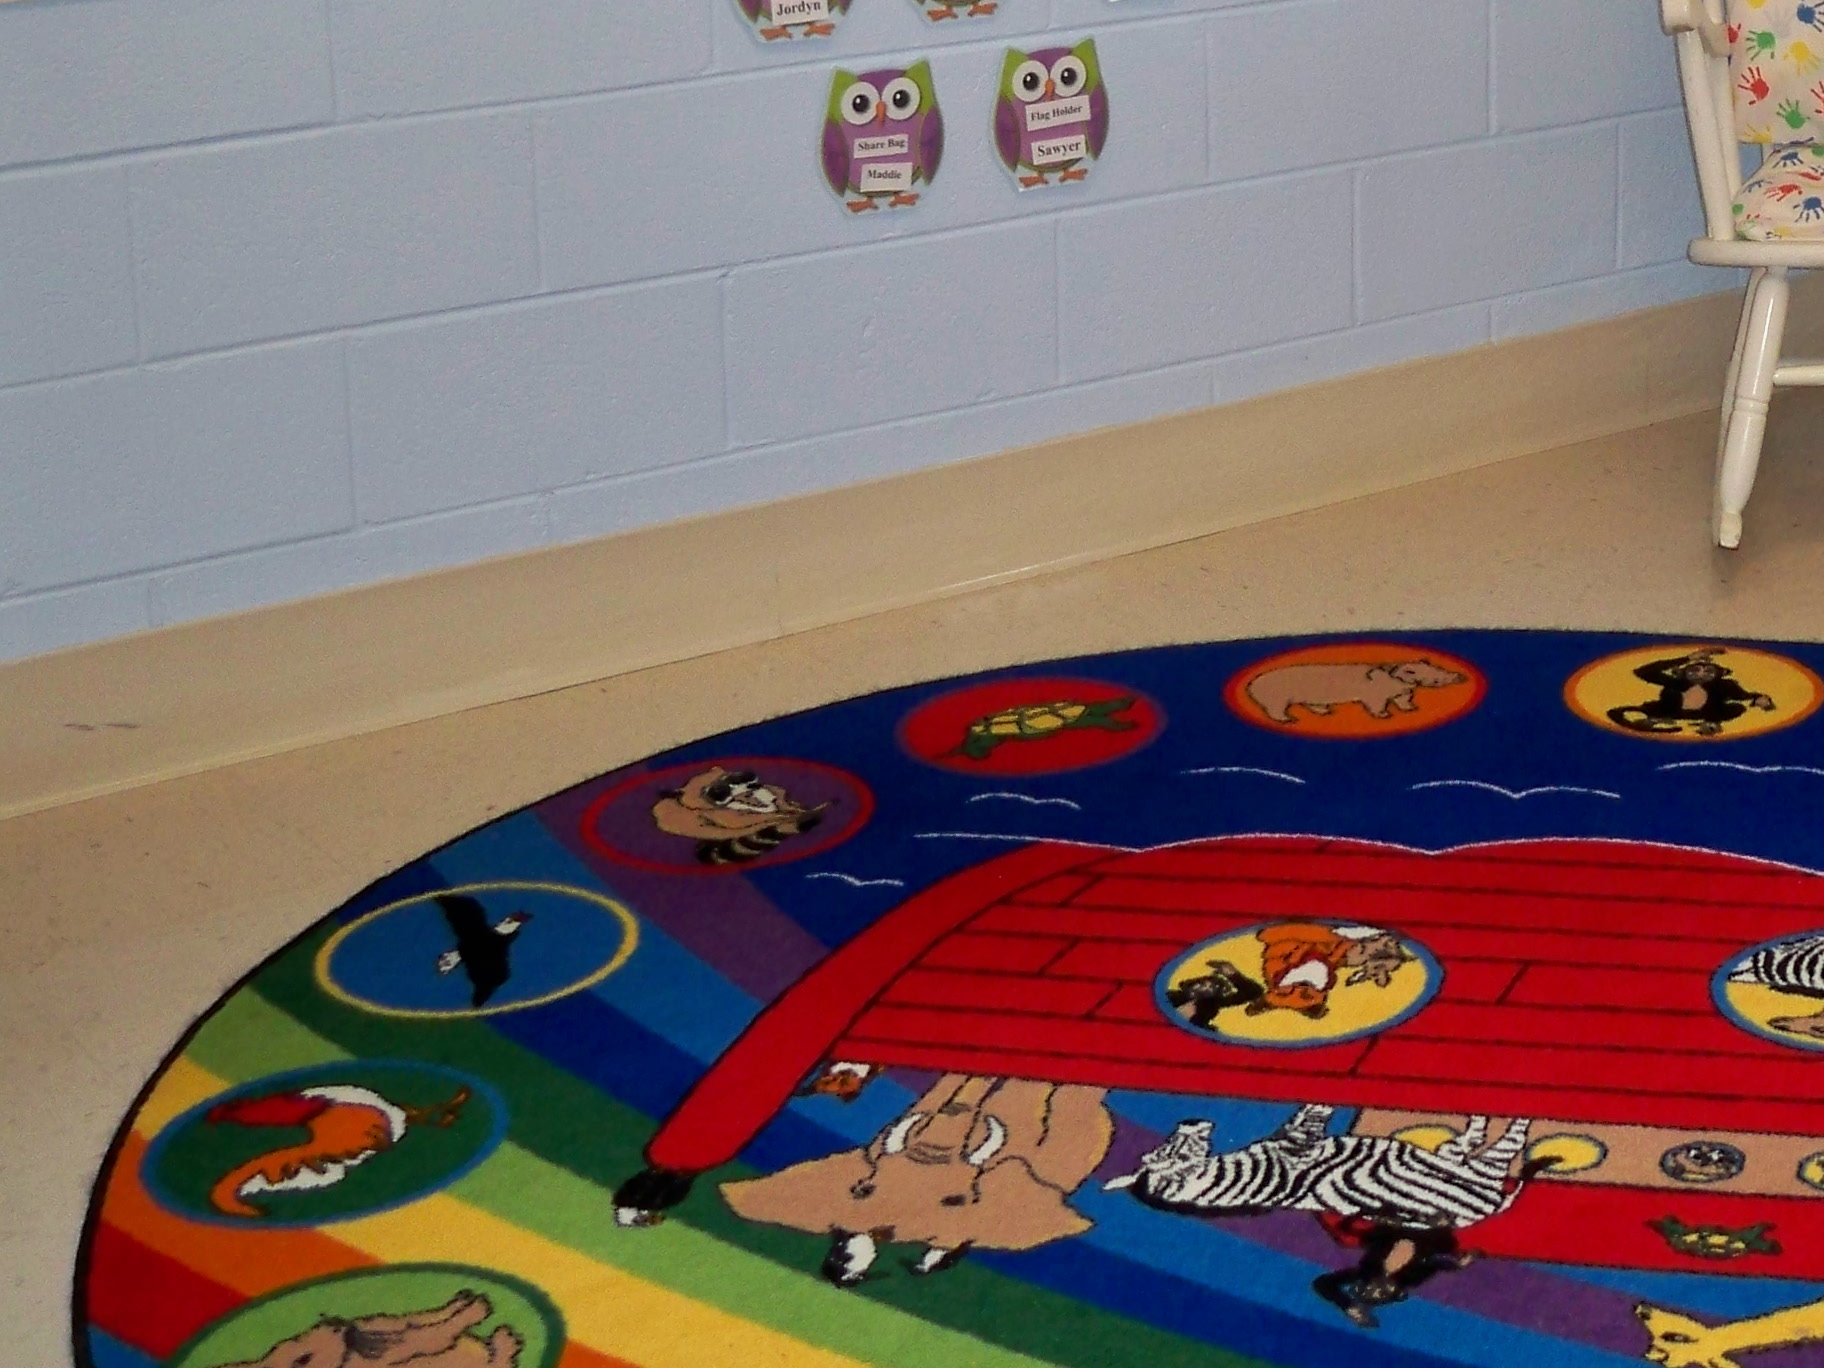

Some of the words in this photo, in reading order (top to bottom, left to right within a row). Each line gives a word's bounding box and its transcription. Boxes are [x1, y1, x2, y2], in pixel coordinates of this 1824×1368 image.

[776, 0, 821, 16] Jordyn
[1031, 112, 1050, 121] Flag
[1052, 105, 1082, 118] Holder
[858, 142, 885, 152] Share
[888, 138, 905, 148] Bag
[1038, 141, 1081, 157] Sawyer
[868, 169, 902, 179] Maddie
